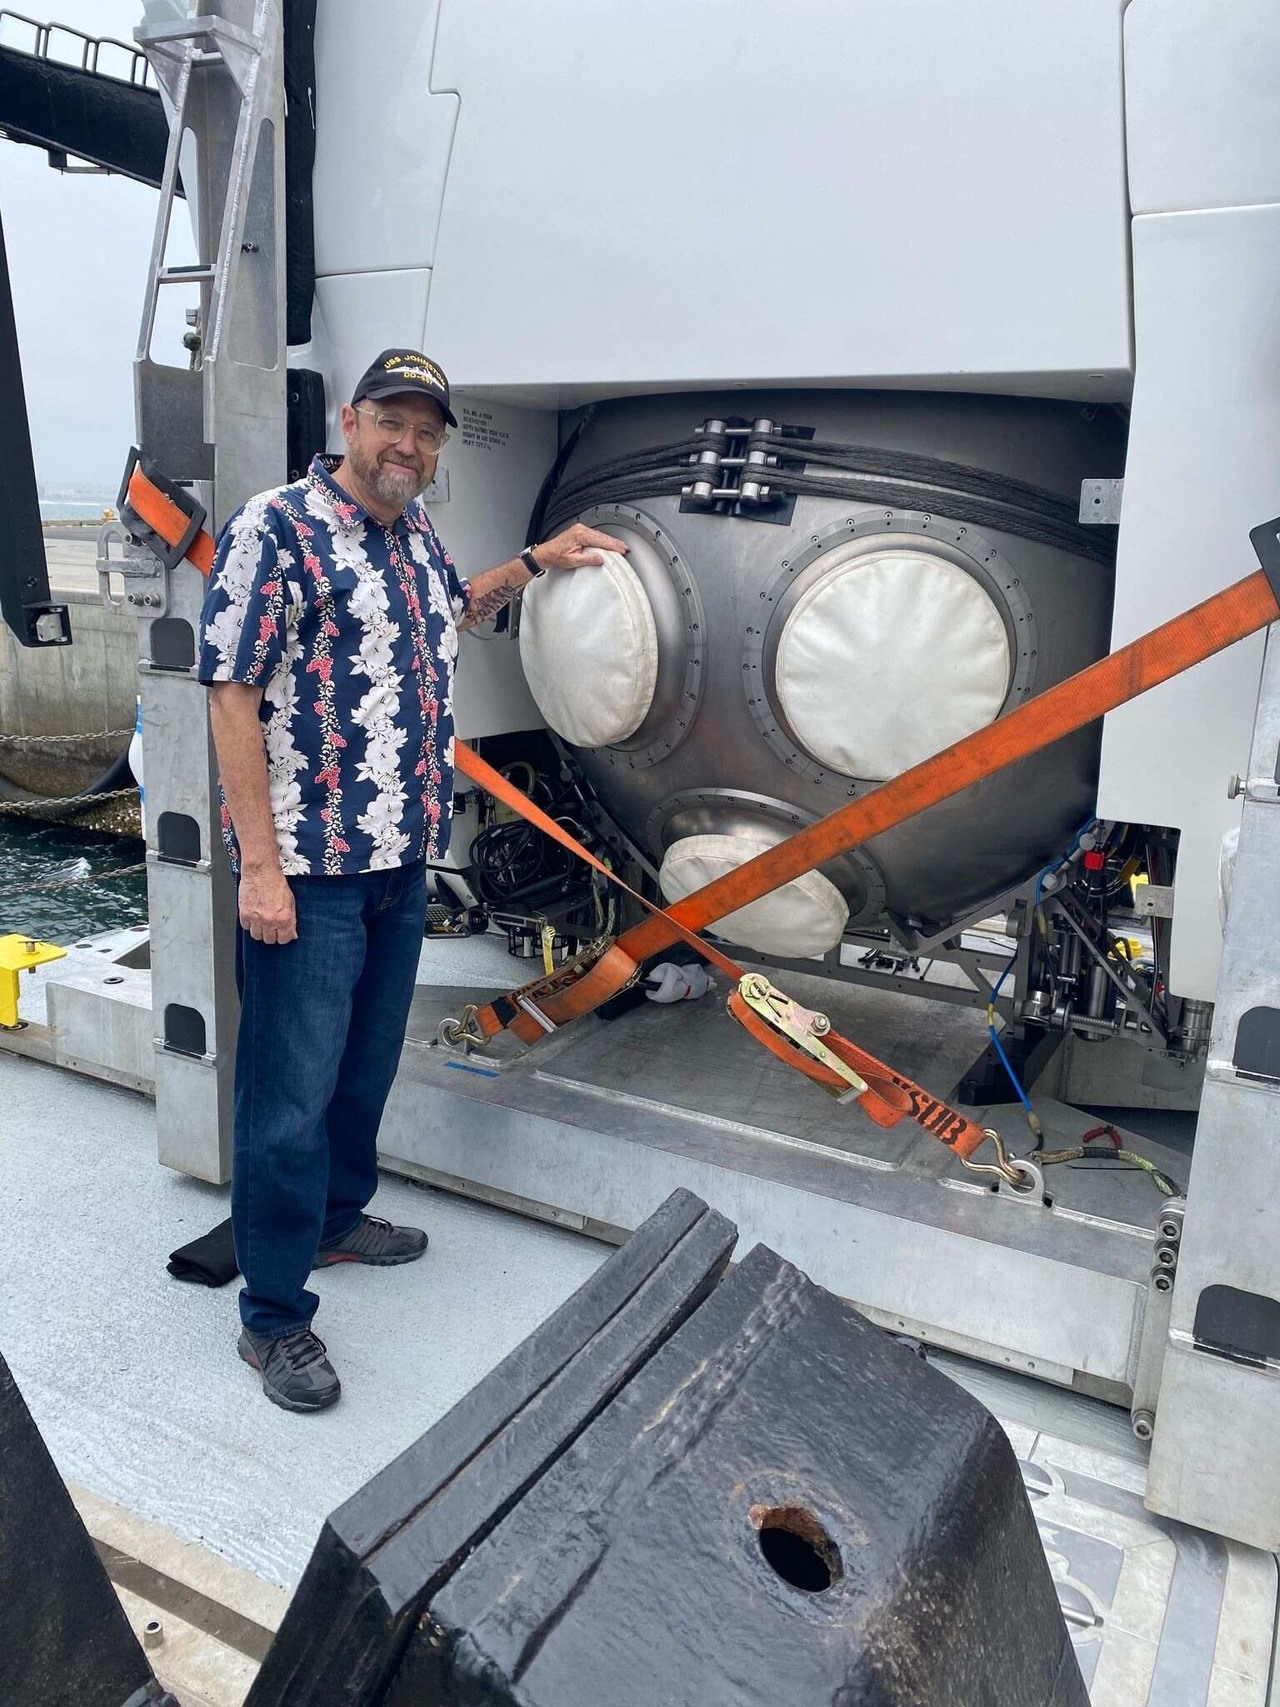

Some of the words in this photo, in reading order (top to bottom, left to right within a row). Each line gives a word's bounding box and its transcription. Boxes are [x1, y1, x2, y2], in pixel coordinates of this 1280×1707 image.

[384, 356, 402, 368] USS
[404, 354, 446, 386] JOHNSTON
[893, 1077, 967, 1145] SUB
